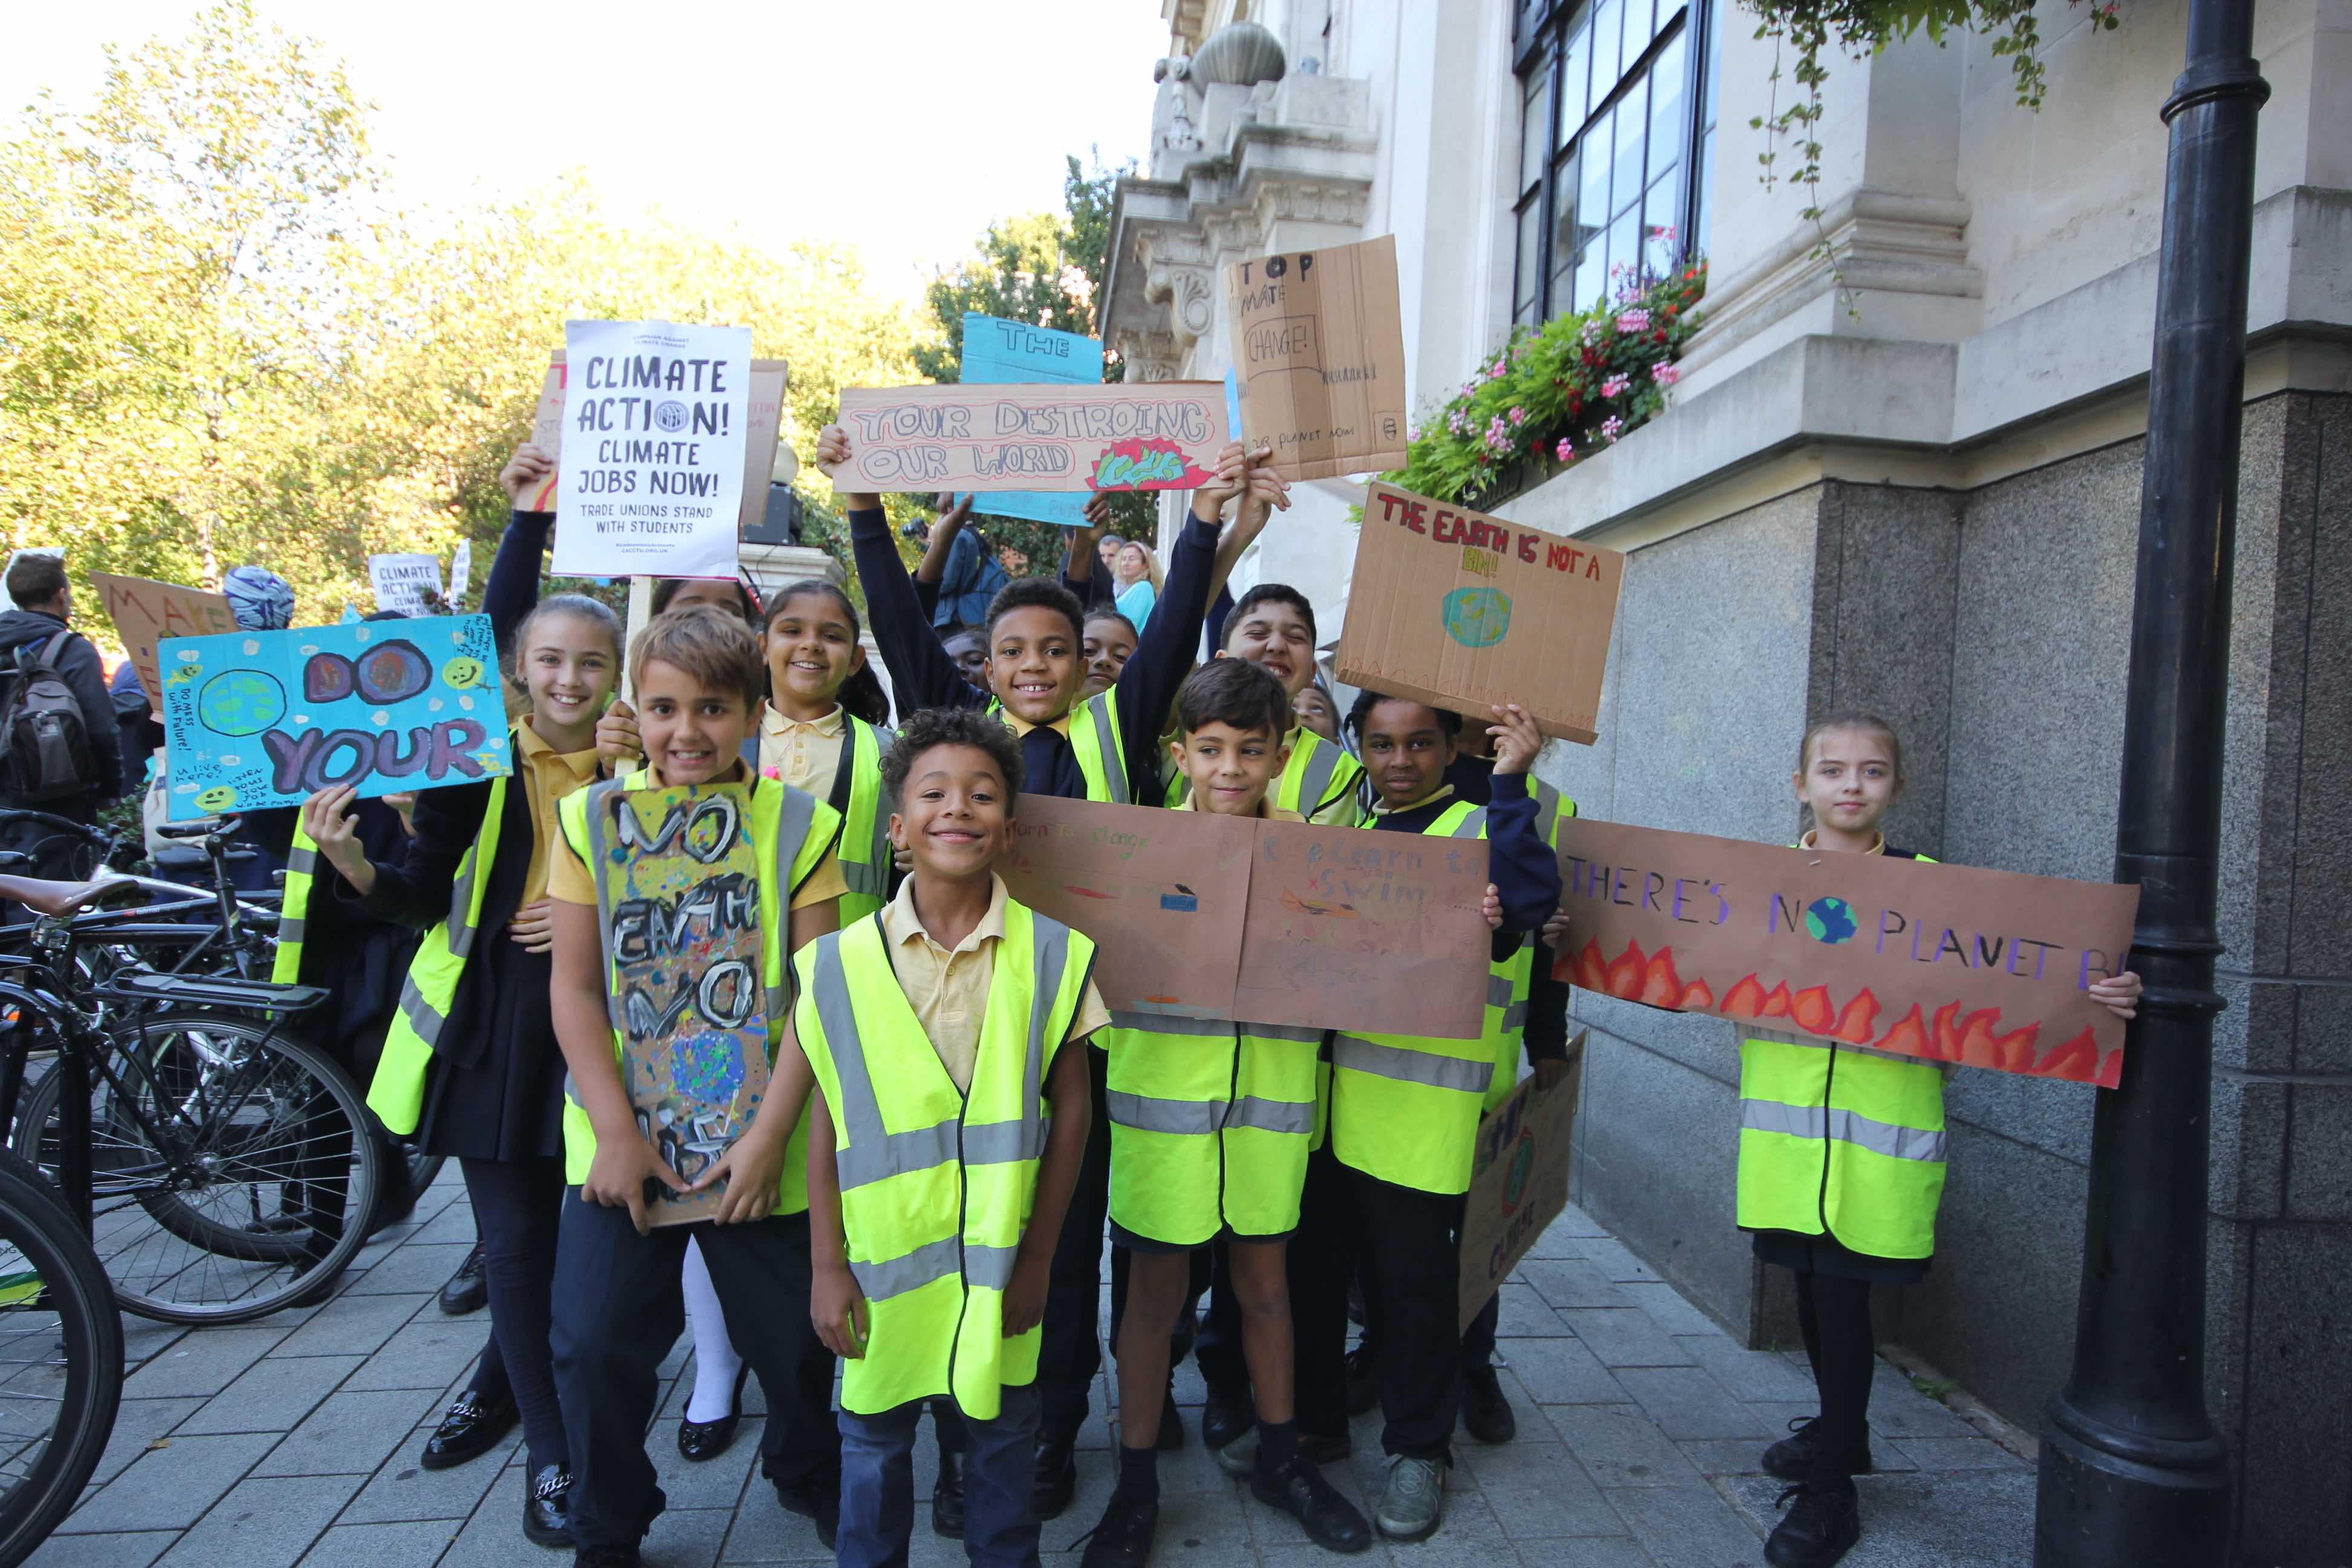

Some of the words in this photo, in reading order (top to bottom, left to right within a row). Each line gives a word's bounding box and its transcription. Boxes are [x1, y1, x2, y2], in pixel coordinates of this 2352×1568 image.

[996, 321, 1070, 359] THE
[1249, 324, 1307, 363] CHANGE!
[586, 354, 728, 393] CLIMATE
[855, 405, 970, 441] YOUR
[1279, 429, 1321, 450] PLANET
[1328, 425, 1354, 439] NOW!
[598, 439, 701, 466] CLIMATE
[863, 445, 949, 479] OUR
[577, 469, 637, 494] JOBS
[650, 470, 718, 498] NOW!
[581, 504, 615, 517] TRADE
[620, 504, 668, 517] UNIONS
[674, 506, 713, 518] STAND
[596, 520, 625, 534] WITH
[630, 521, 693, 534] STUDENTS
[1377, 492, 1428, 535] THE
[1432, 509, 1509, 555] EARTH
[1517, 533, 1541, 564] IS
[1546, 542, 1584, 575] NOT
[1586, 554, 1601, 581] A
[379, 566, 432, 581] CLIMATE
[1462, 546, 1499, 578] BIN!
[109, 583, 227, 635] MAKE
[261, 718, 487, 795] YOUR
[610, 792, 742, 864] NO
[1566, 854, 1730, 927] THERE'S
[1875, 909, 2065, 980] PLANET
